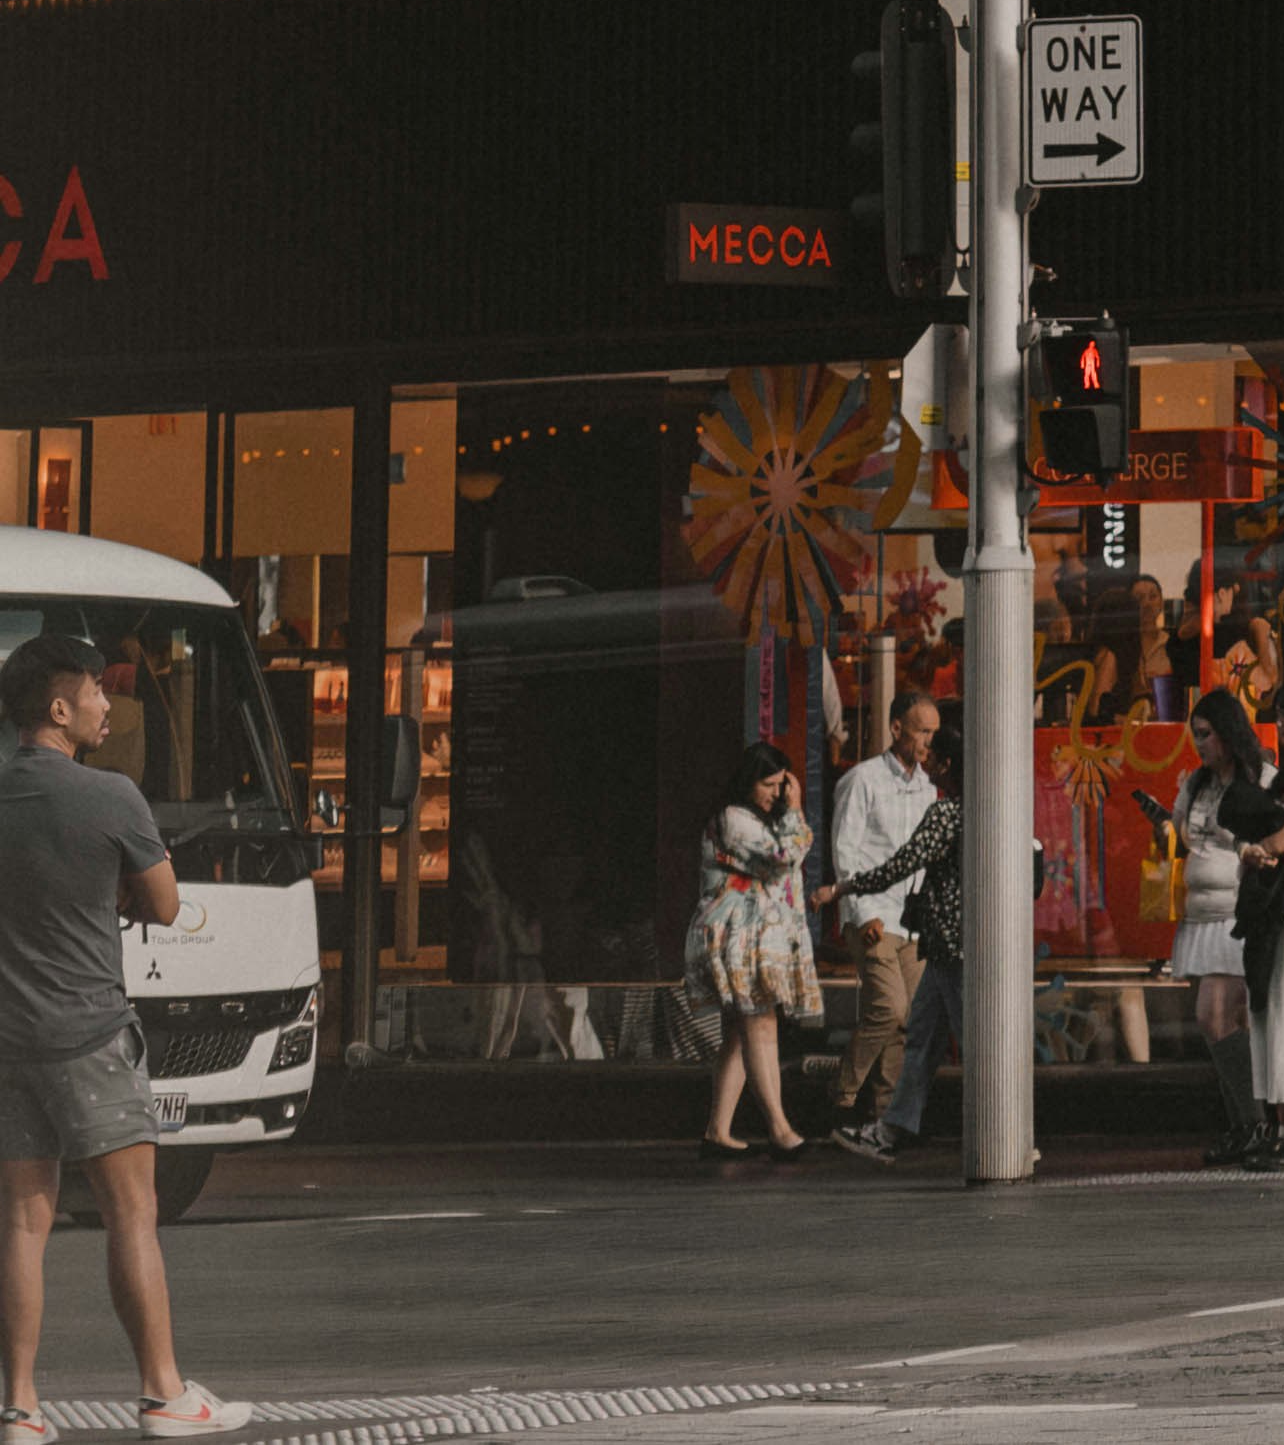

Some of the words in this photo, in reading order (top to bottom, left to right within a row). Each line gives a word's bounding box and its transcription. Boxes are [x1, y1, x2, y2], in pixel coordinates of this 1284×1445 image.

[1046, 34, 1122, 72] ONE
[1040, 84, 1127, 123] WAY
[688, 220, 832, 267] MECCA
